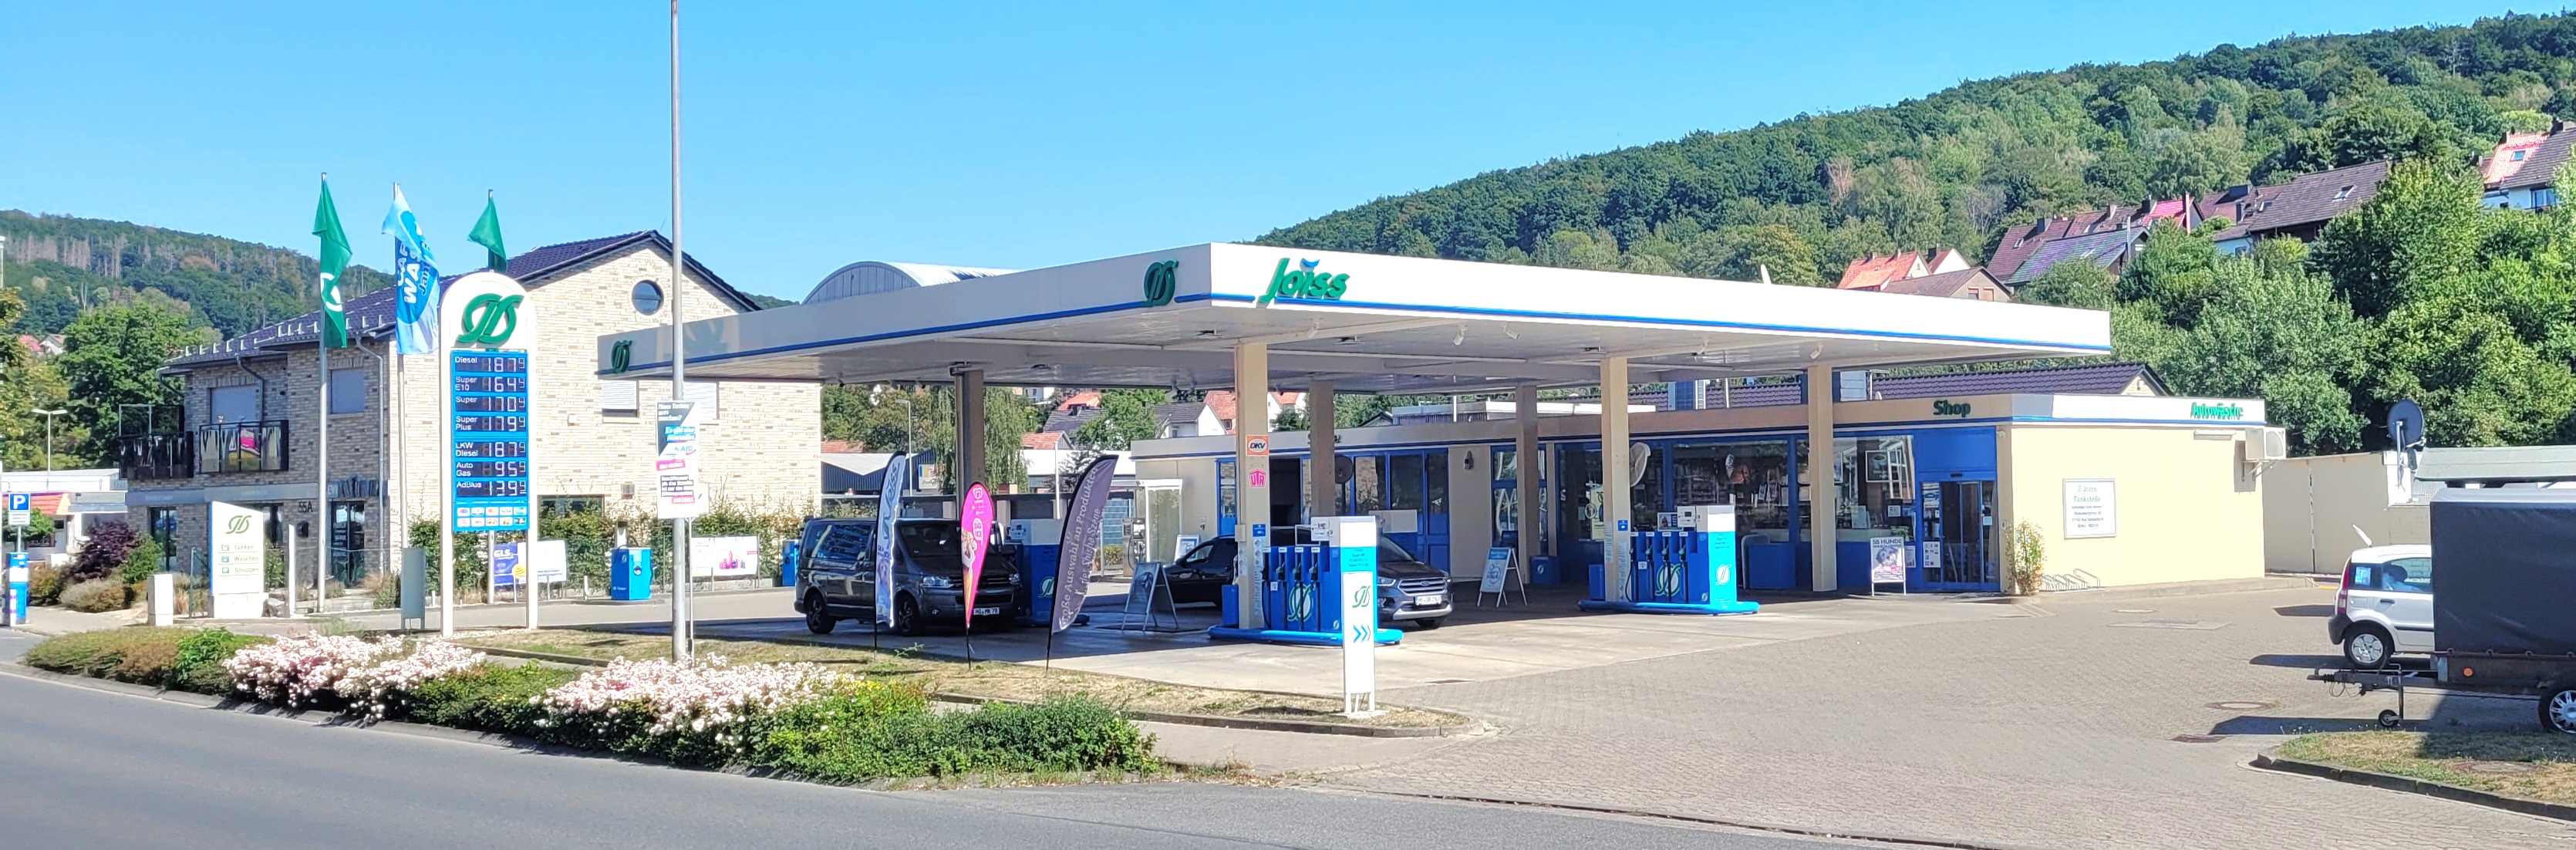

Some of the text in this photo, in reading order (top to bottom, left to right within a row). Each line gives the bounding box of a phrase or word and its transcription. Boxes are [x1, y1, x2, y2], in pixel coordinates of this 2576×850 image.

[1933, 400, 1971, 418] Shop
[680, 445, 693, 454] AfD
[1250, 473, 1265, 486] UTA
[13, 494, 26, 510] P
[1076, 467, 1098, 525] Produkten
[298, 501, 313, 513] 55A
[1087, 508, 1101, 535] Szene
[1074, 526, 1082, 540] an
[494, 548, 511, 558] GLS
[1064, 542, 1079, 593] Auswahl
